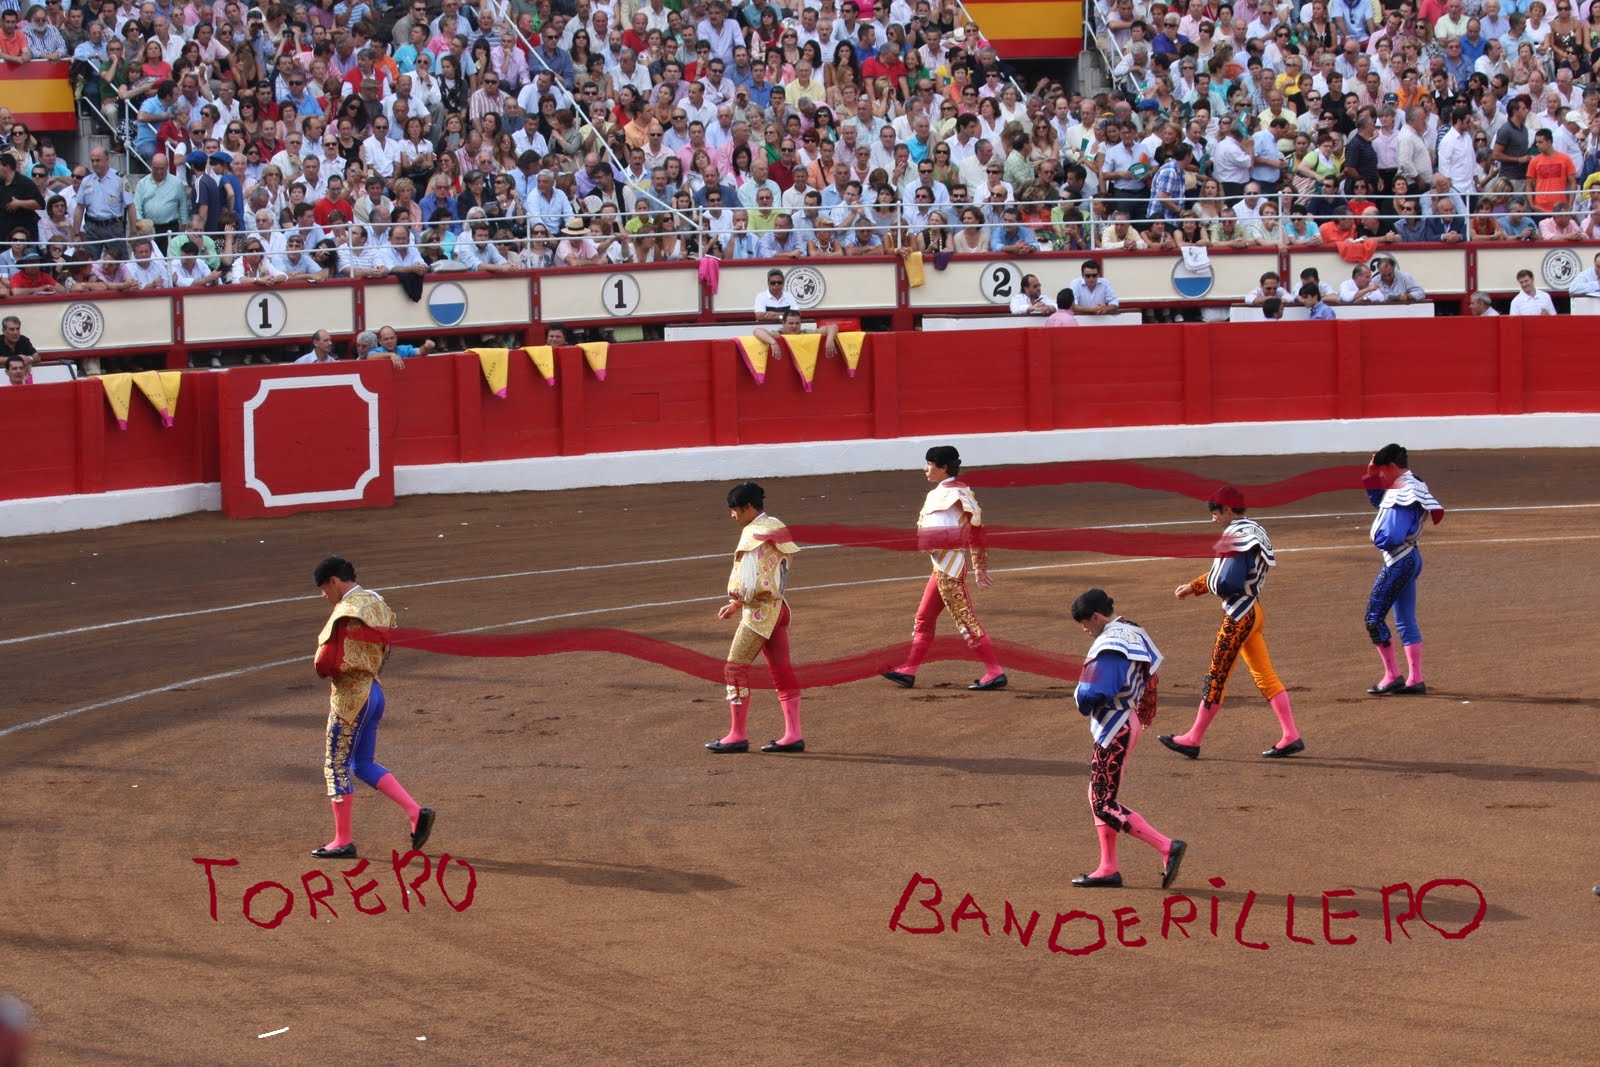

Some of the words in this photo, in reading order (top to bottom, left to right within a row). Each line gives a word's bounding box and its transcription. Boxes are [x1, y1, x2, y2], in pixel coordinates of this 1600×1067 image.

[614, 279, 627, 309] 1
[992, 267, 1012, 298] 2
[258, 298, 272, 329] 1
